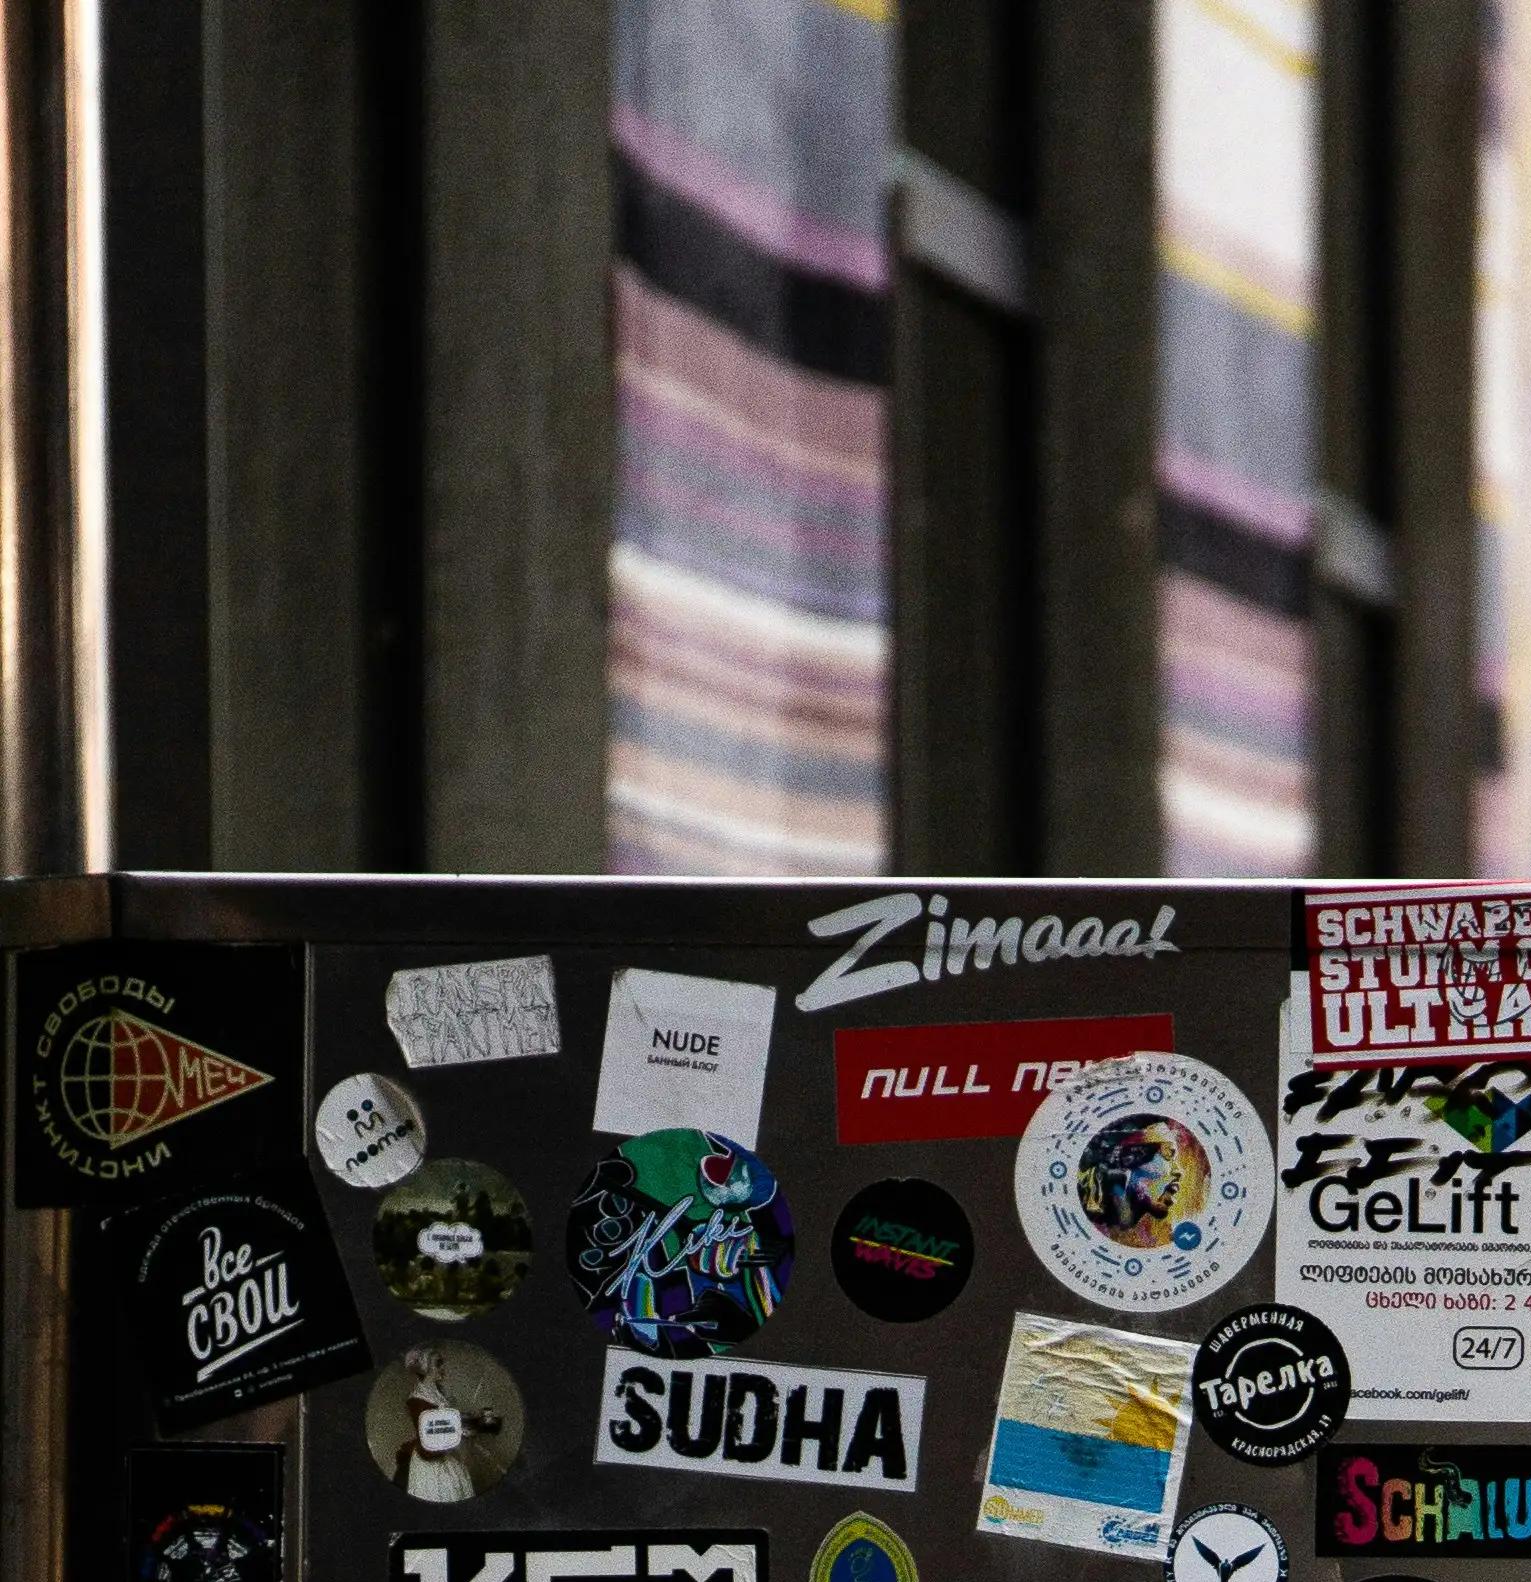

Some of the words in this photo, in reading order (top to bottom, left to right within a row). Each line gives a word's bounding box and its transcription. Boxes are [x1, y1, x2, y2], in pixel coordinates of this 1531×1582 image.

[1320, 938, 1503, 992] STURM
[38, 975, 175, 1058] СВОБОДЫ
[647, 1053, 689, 1070] БАННЫЙ
[652, 1028, 721, 1056] NUDE
[34, 1073, 172, 1180] ИНСТИНКТ
[1308, 1174, 1520, 1234] GeLift
[854, 1213, 960, 1258] INSTANT
[1504, 1295, 1516, 1311] 2
[1208, 1311, 1304, 1353] ШАВЕРМЕННАЯ
[1460, 1336, 1517, 1361] 24/7
[1199, 1355, 1334, 1410] Тарелка
[609, 1365, 908, 1480] SUDHA
